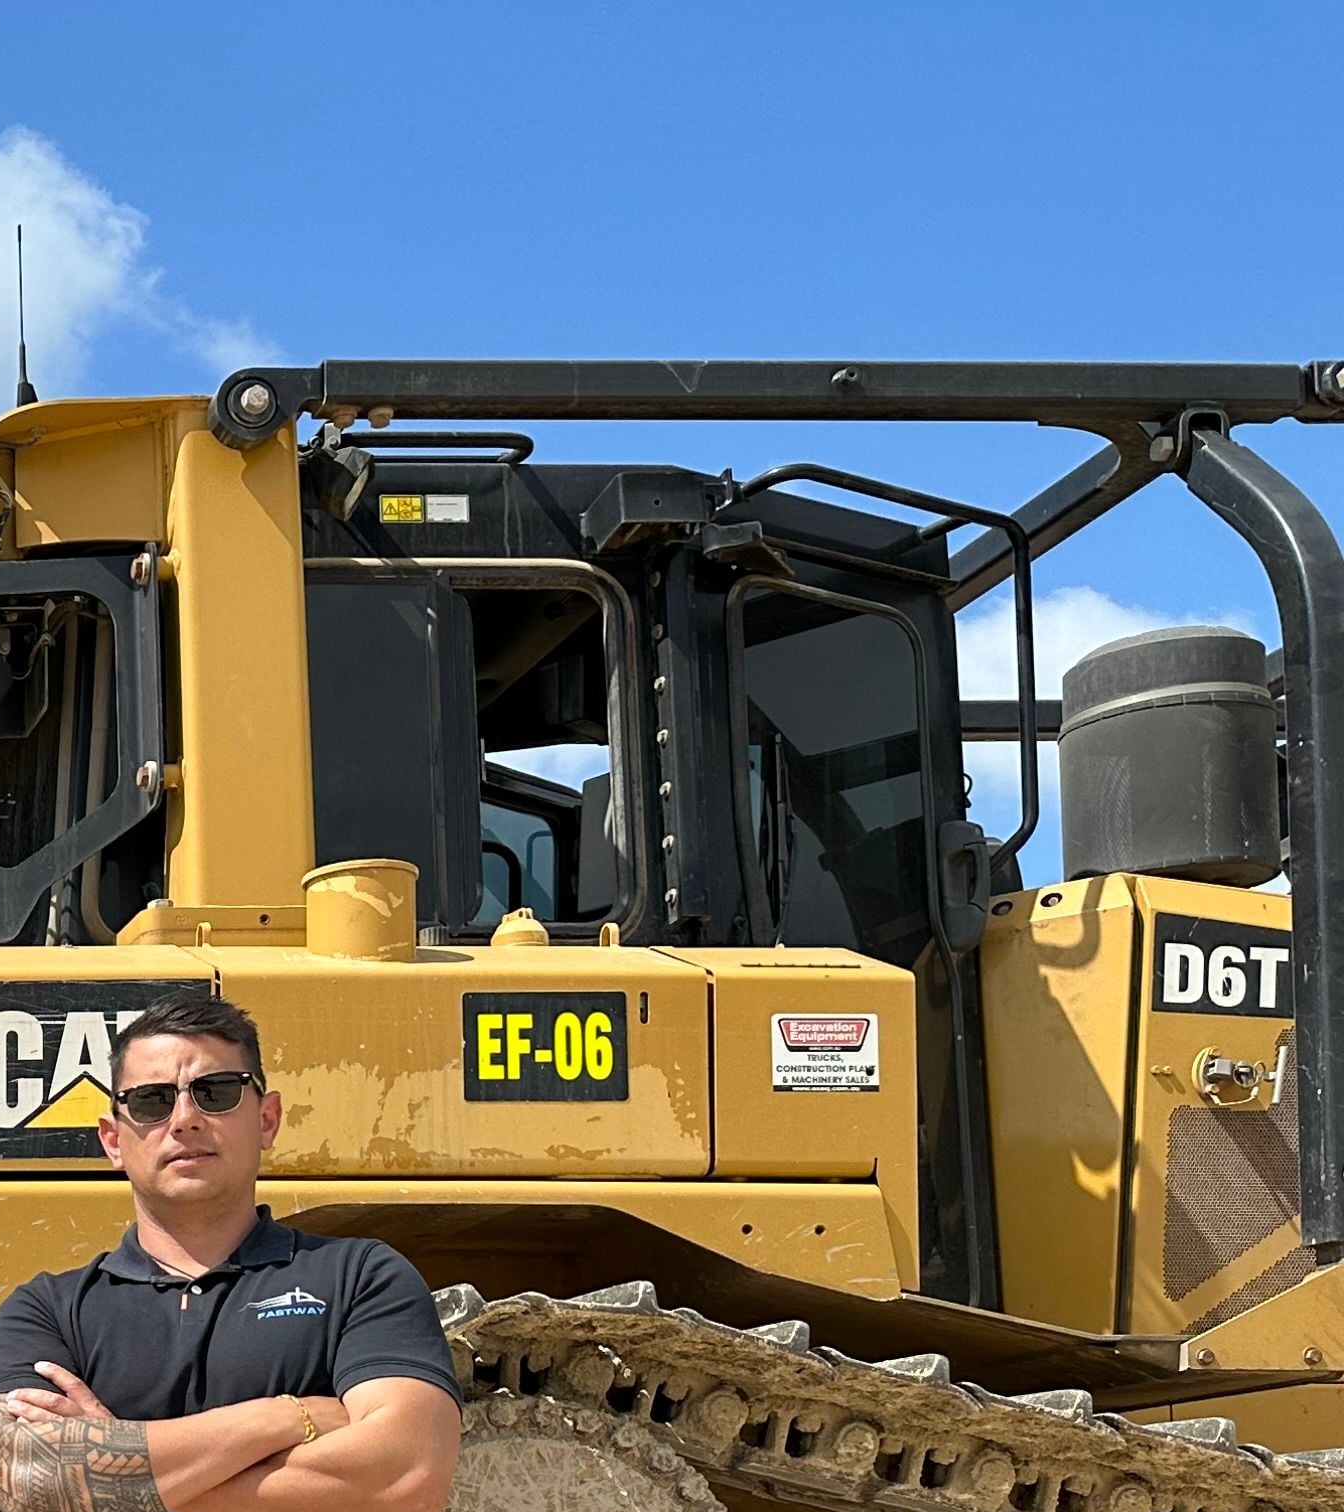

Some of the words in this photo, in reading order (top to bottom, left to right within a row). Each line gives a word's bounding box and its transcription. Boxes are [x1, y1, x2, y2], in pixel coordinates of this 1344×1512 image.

[1163, 942, 1289, 1009] D6T
[789, 1022, 857, 1031] Excavation
[789, 1032, 859, 1042] Equipment
[477, 1011, 614, 1080] EF-06
[807, 1054, 844, 1063] TRUCKS,
[257, 1307, 326, 1320] FASTWAY
